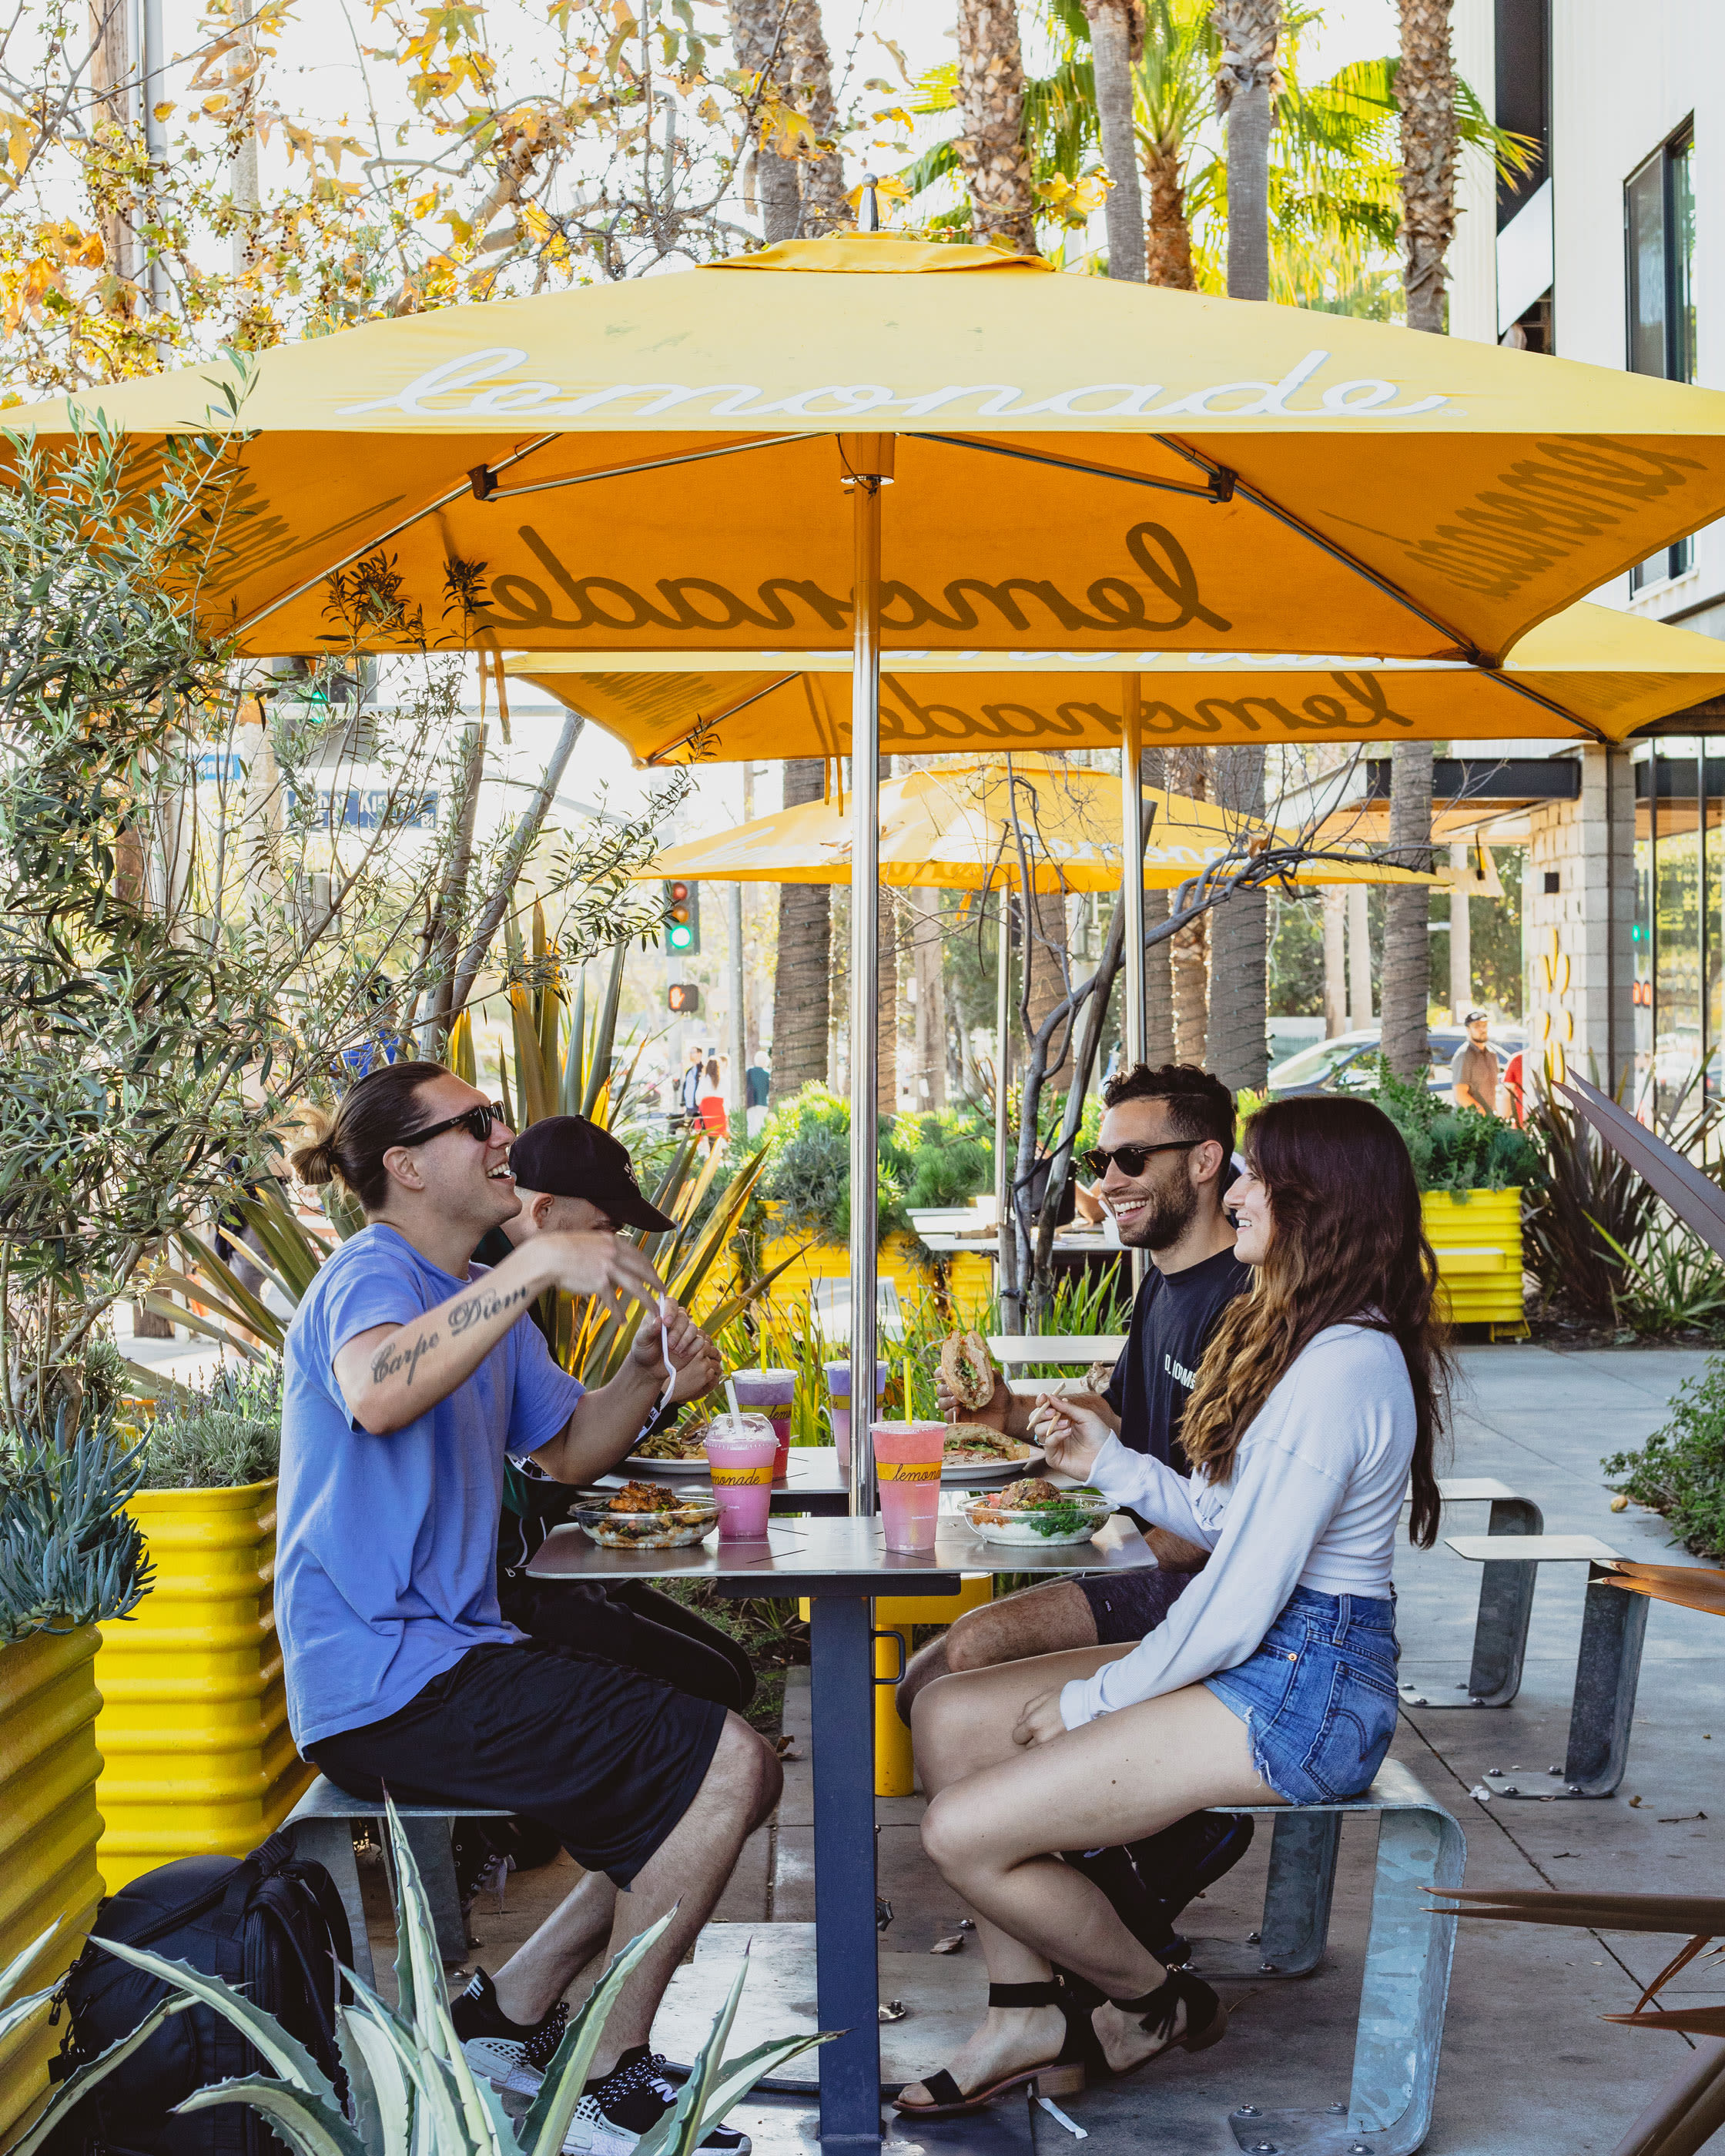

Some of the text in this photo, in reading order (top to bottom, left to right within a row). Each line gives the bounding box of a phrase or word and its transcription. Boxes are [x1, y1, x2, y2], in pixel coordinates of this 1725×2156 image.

[334, 346, 1451, 417] lemonade
[370, 1284, 528, 1386] Carpe Diem
